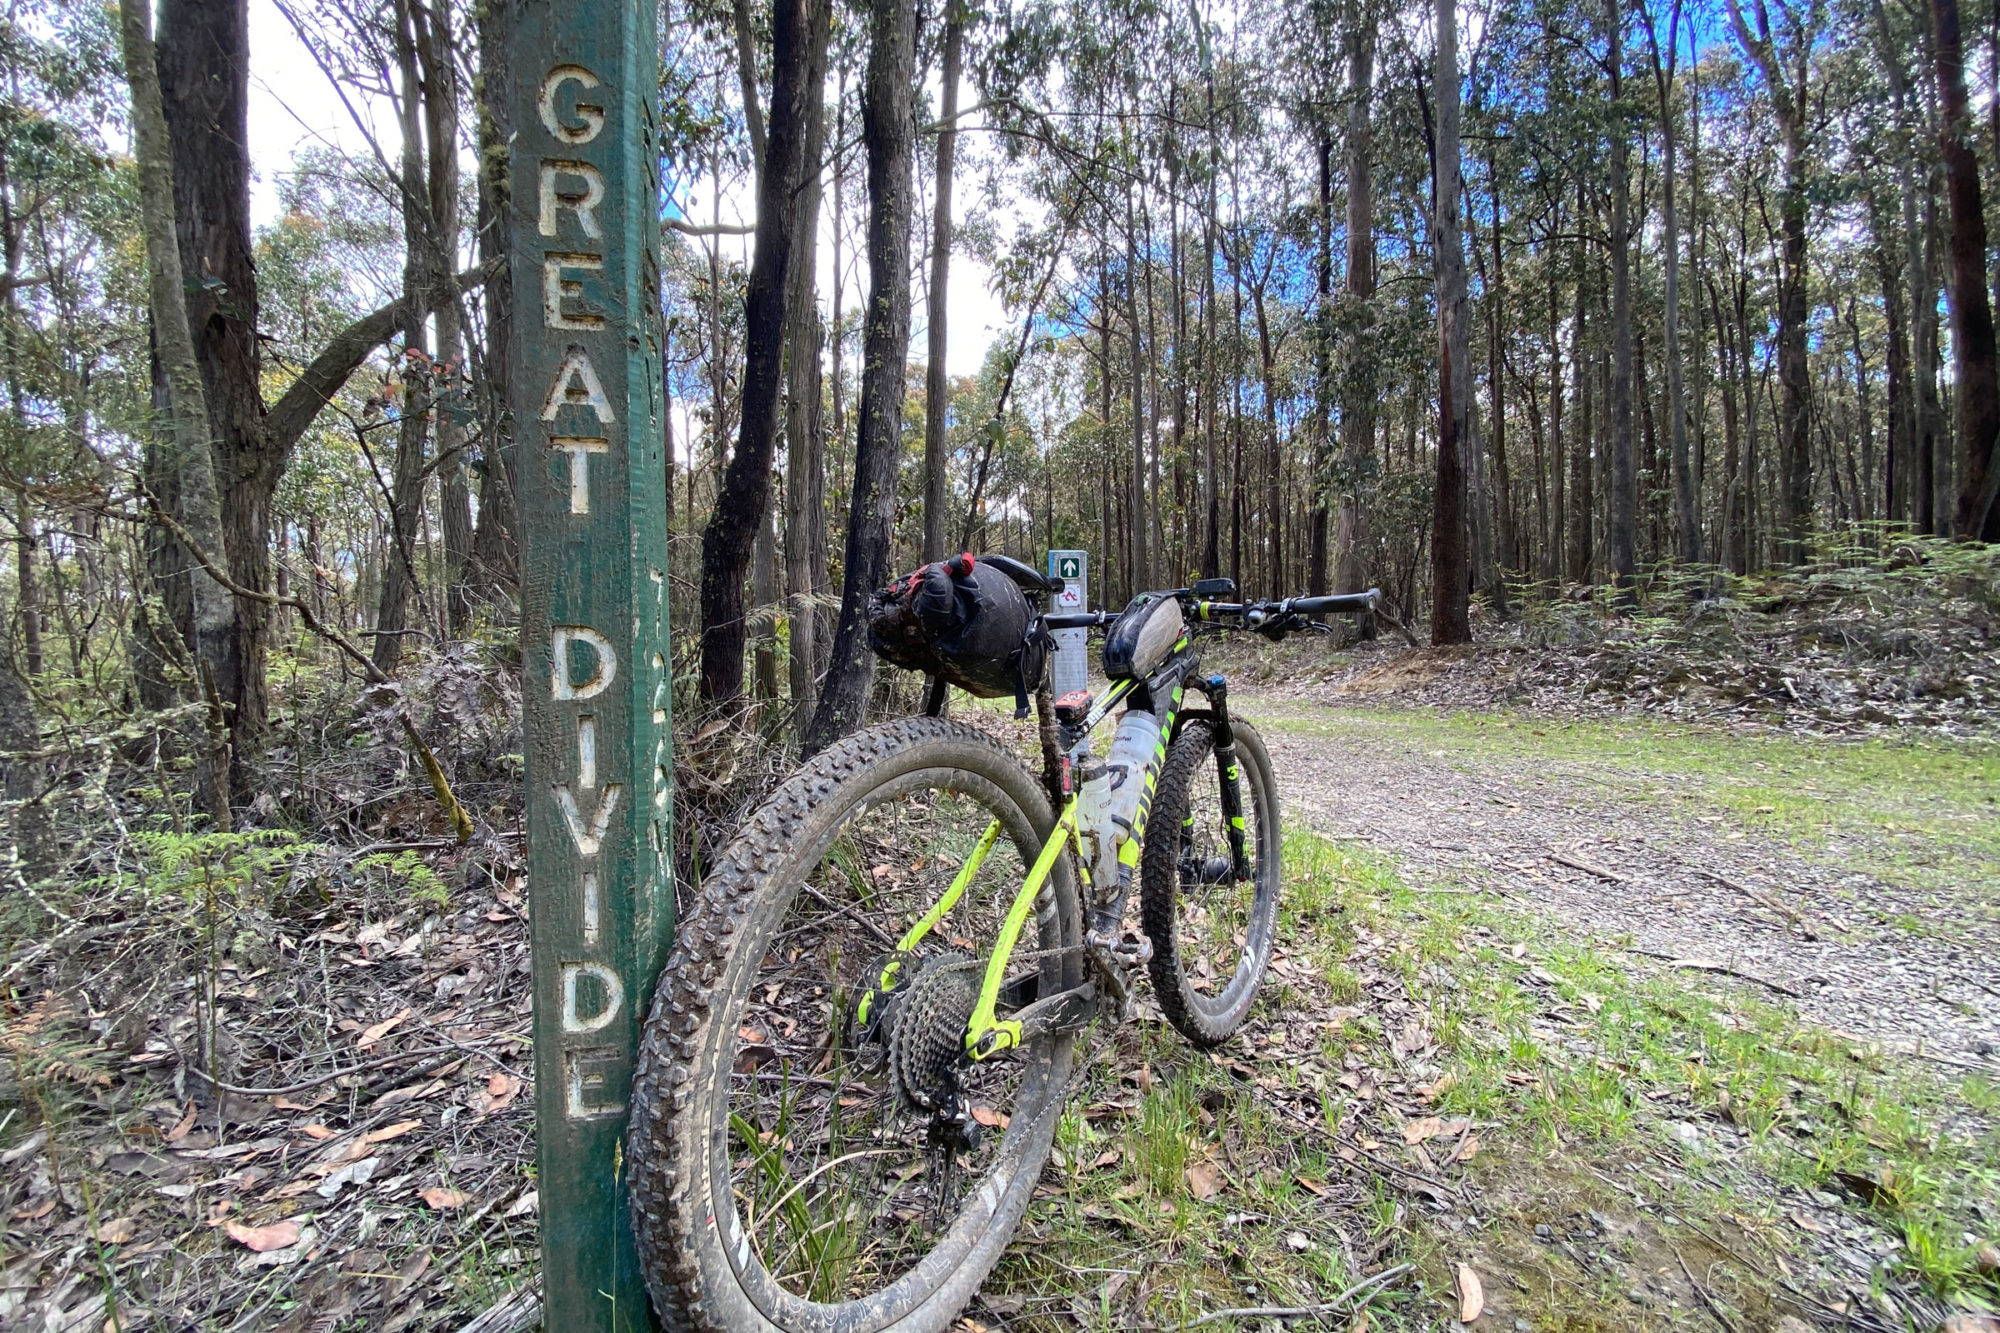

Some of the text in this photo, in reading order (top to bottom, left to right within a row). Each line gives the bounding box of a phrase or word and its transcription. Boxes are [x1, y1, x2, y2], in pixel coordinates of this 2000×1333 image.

[536, 63, 627, 1119] GREAT DIVIDE
[1251, 937, 1271, 987] MEZCAL
